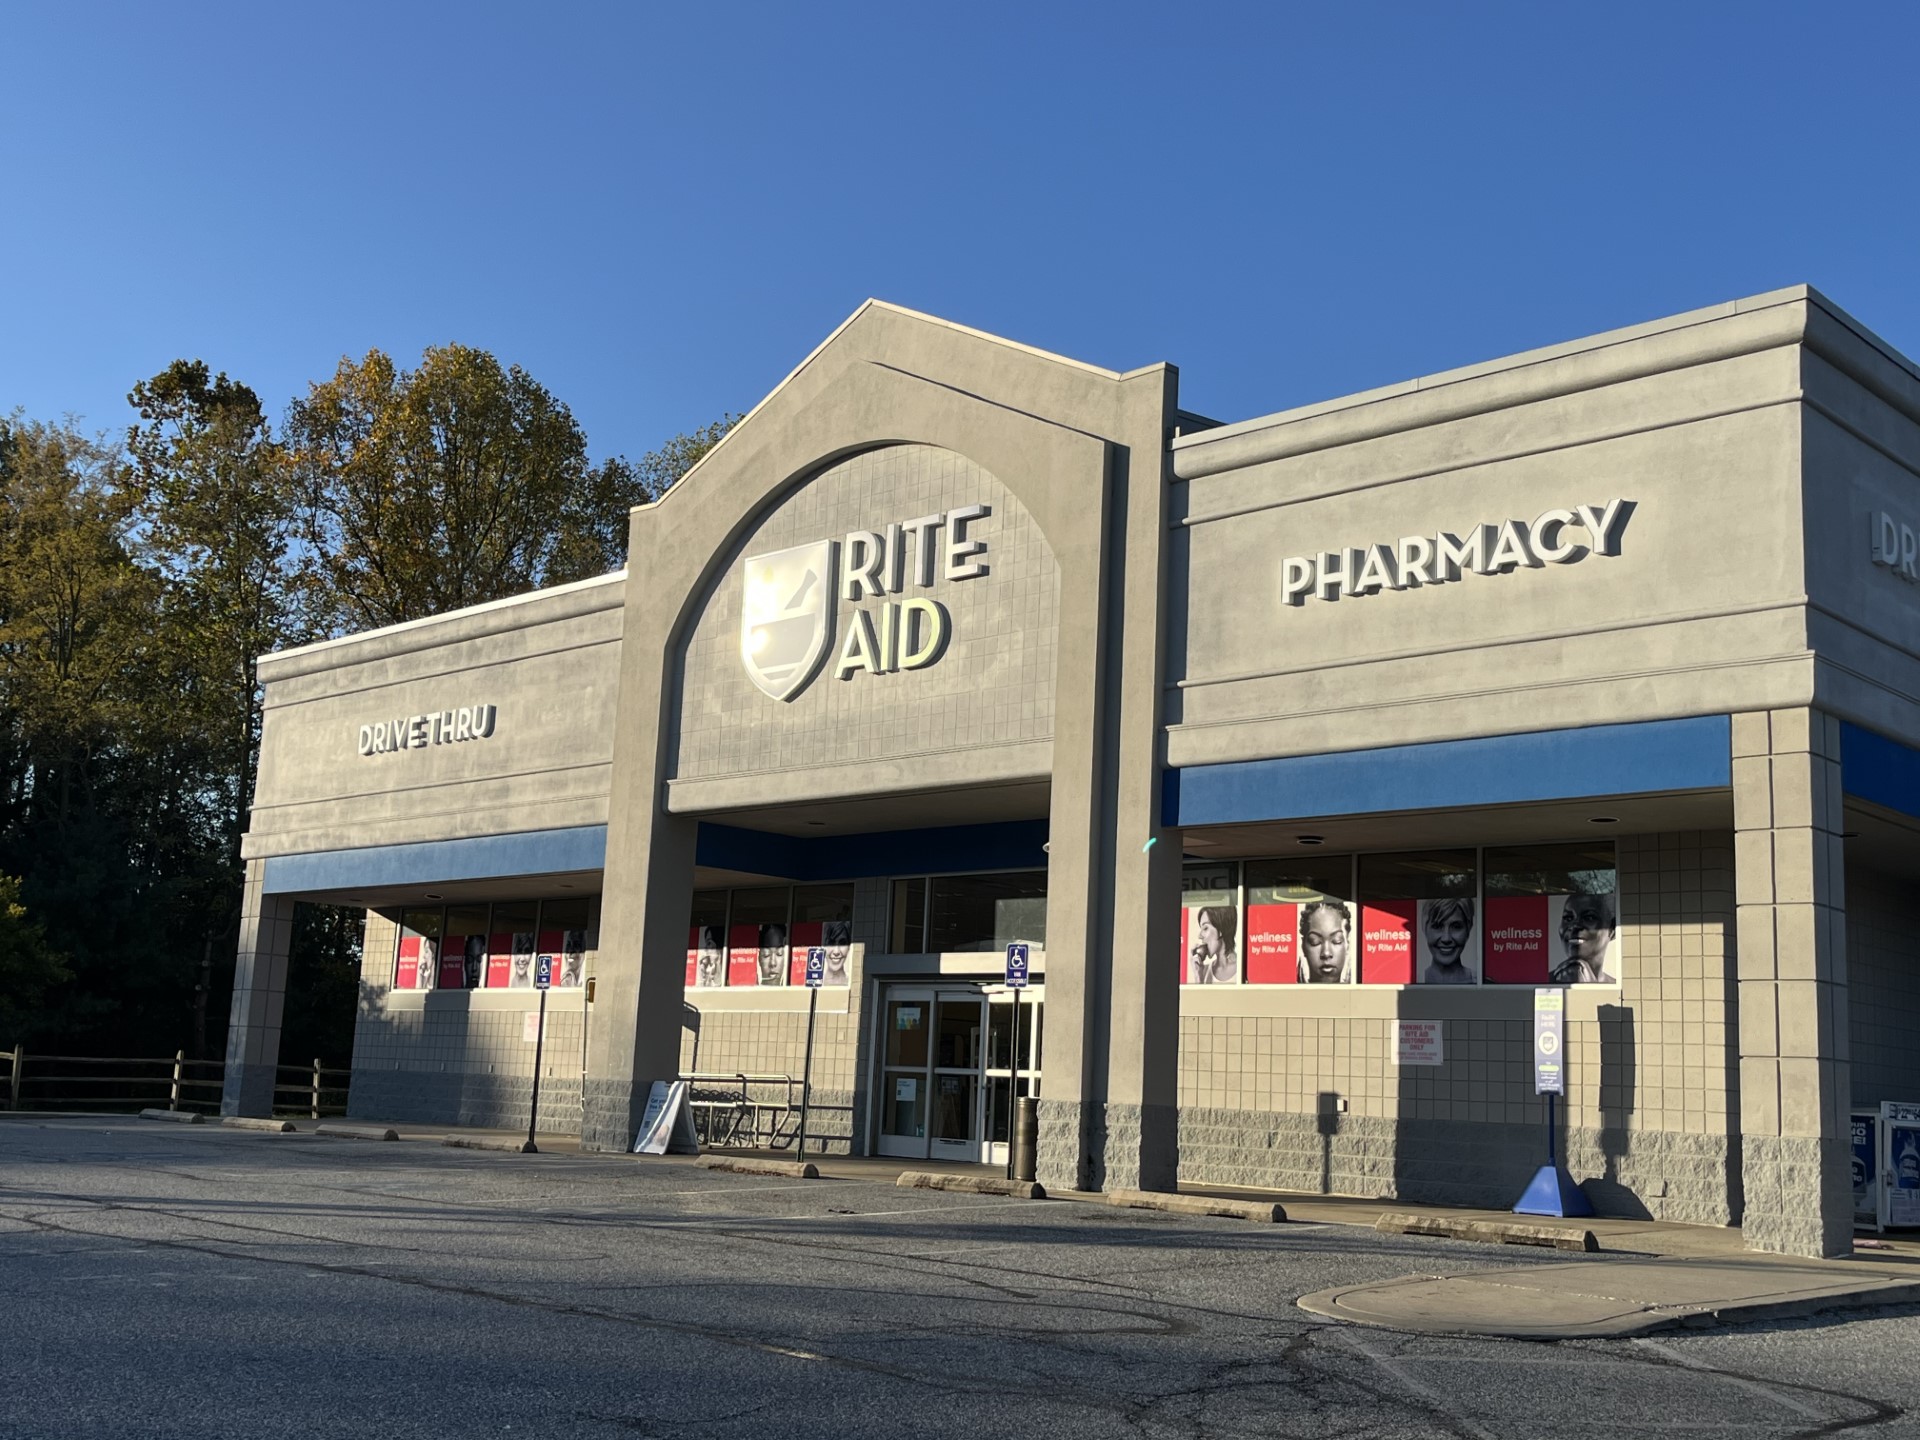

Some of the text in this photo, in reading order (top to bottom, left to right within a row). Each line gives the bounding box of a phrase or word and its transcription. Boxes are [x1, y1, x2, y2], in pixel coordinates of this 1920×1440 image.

[842, 504, 991, 601] RITE
[1281, 498, 1638, 607] PHARMACY
[1871, 511, 1920, 585] DR
[834, 597, 951, 680] AID
[1249, 932, 1292, 943] wellness
[1364, 928, 1411, 941] wellness
[1491, 927, 1542, 940] wellness
[1251, 944, 1289, 954] by Rite Aid
[1367, 943, 1408, 953] by Rite Aid
[1494, 942, 1539, 953] by Rite Aid
